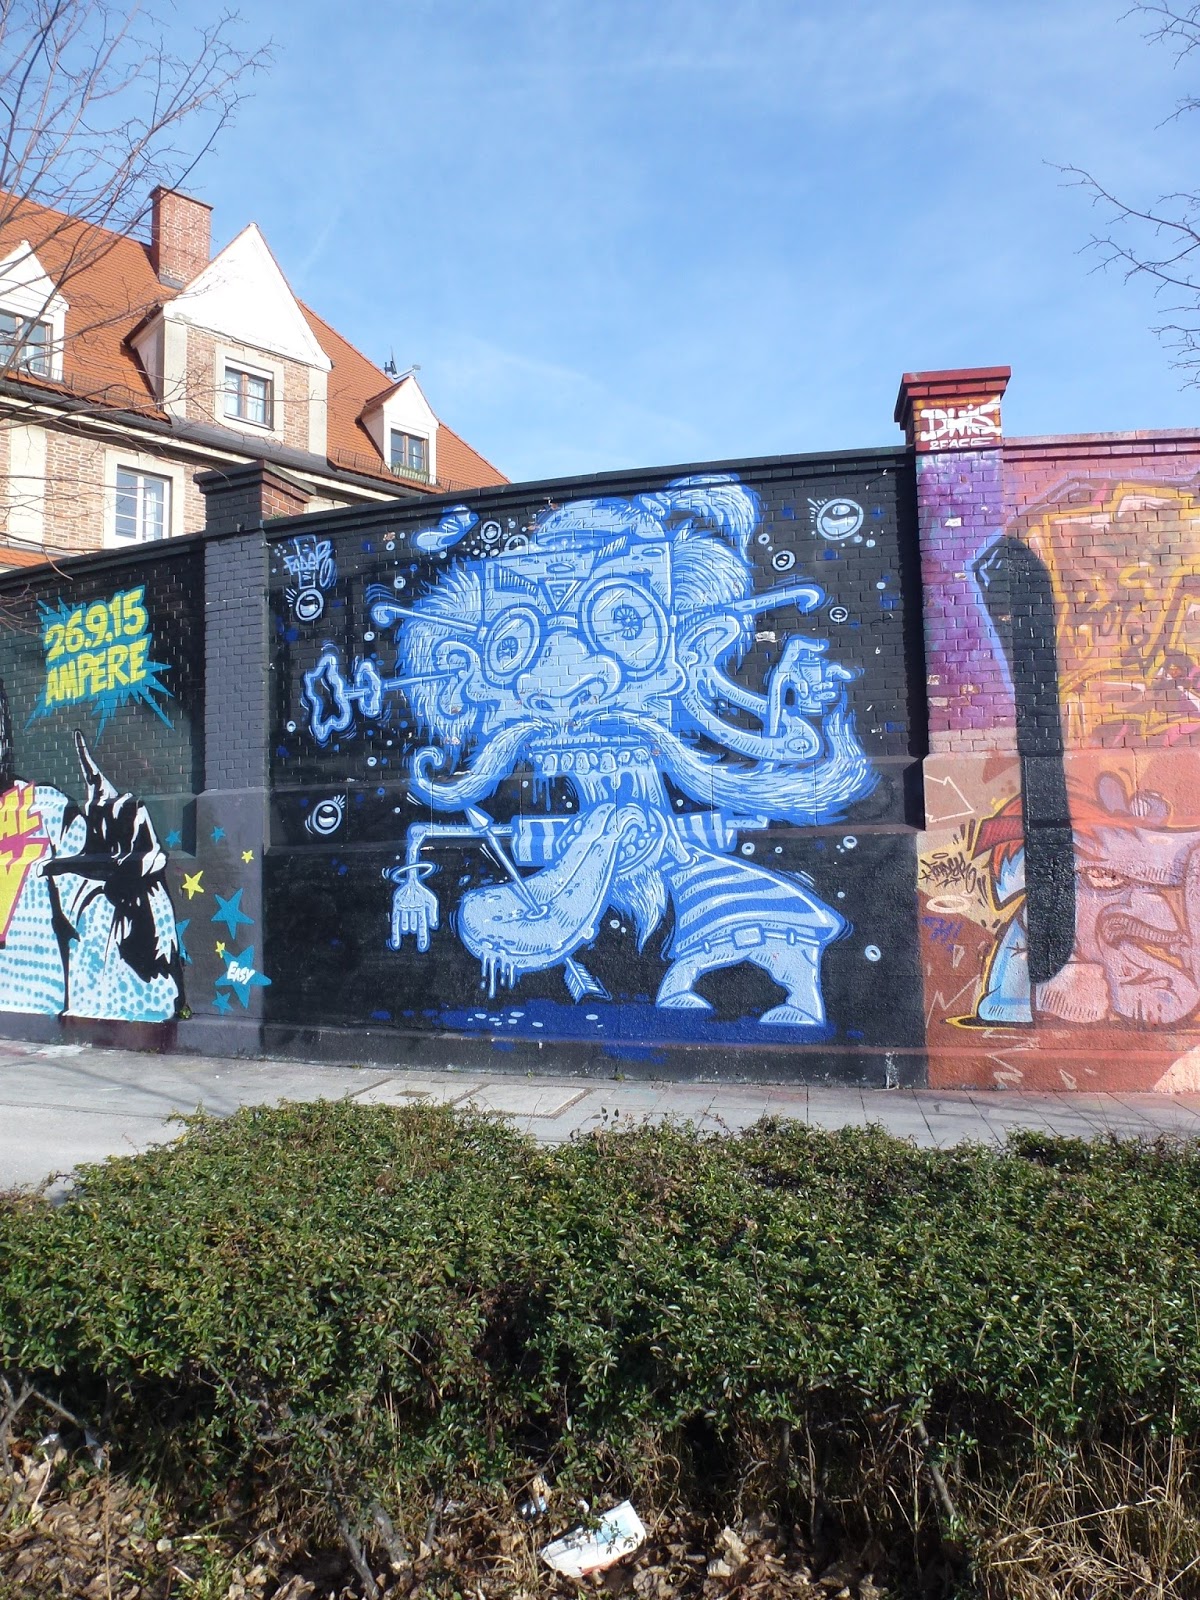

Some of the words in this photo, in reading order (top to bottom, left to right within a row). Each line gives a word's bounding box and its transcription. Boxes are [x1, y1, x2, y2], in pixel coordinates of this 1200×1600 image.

[45, 589, 146, 662] 26.9.15
[45, 637, 148, 707] AMPERE
[227, 961, 256, 985] EASY
